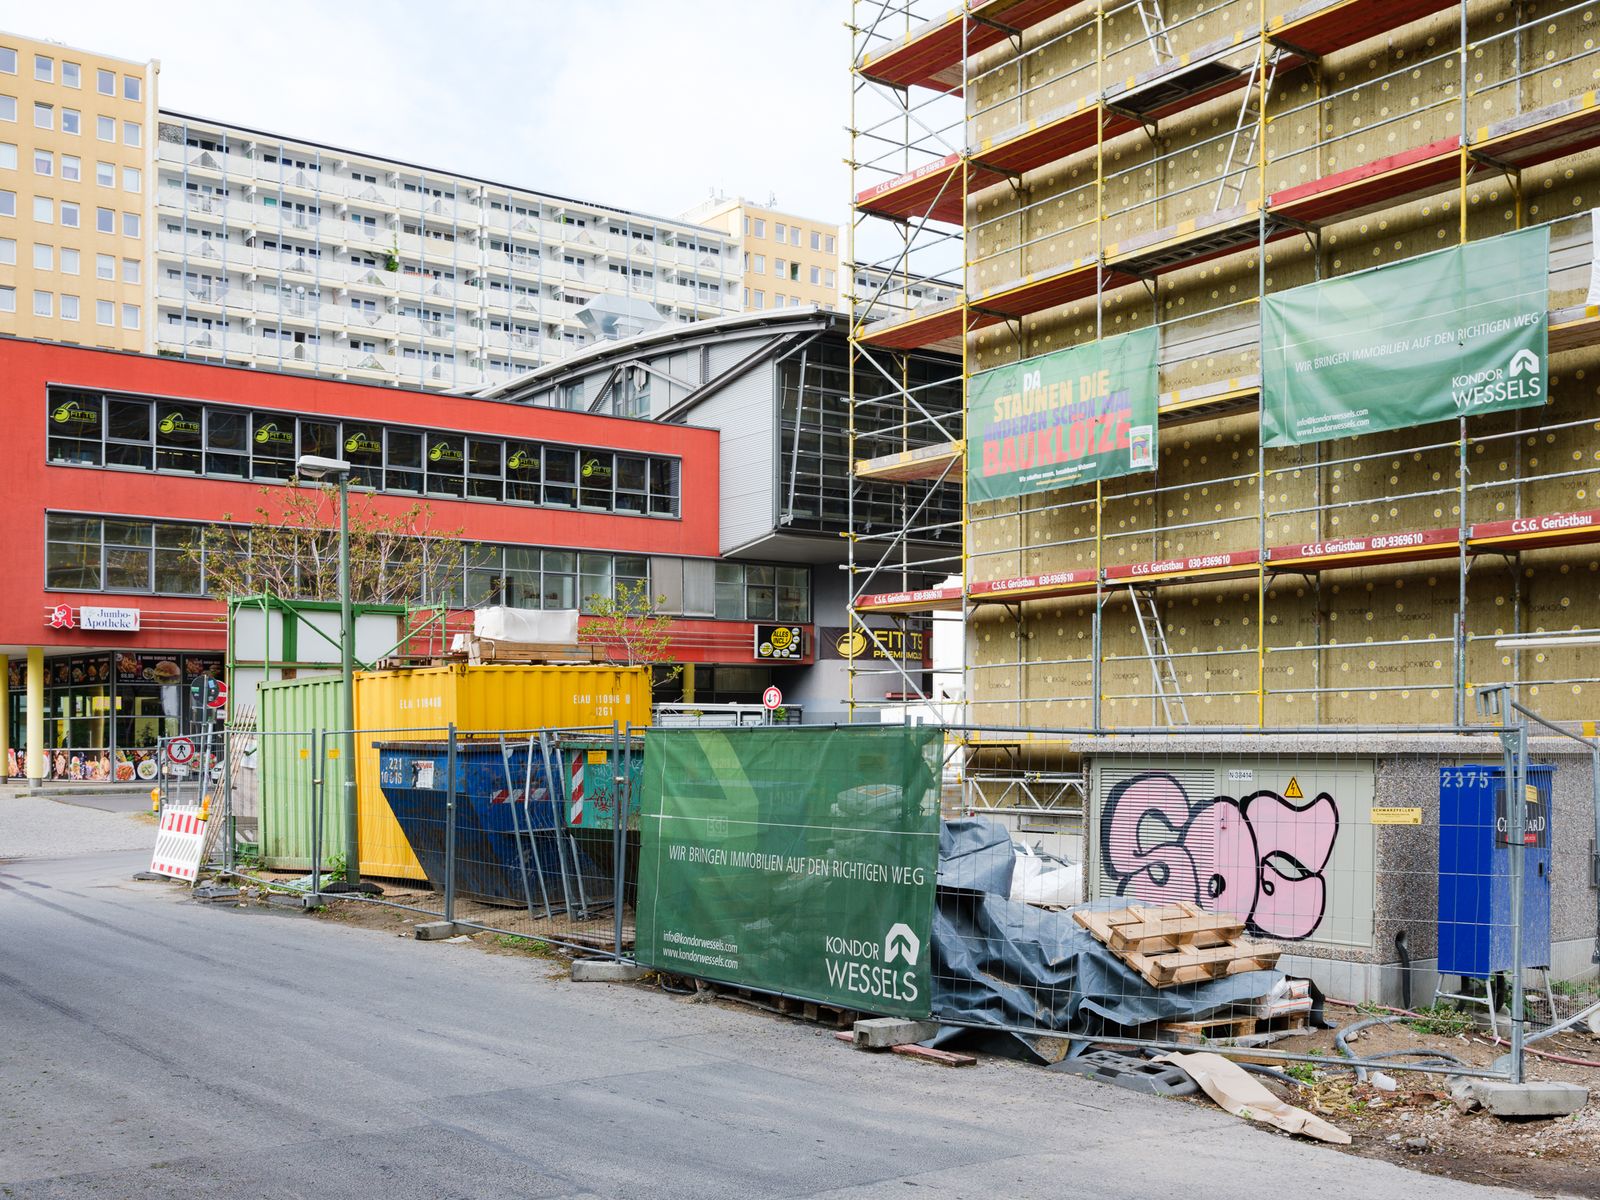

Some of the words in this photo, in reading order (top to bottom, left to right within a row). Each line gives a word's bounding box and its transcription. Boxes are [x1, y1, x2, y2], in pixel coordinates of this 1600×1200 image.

[1295, 361, 1313, 373] WIR
[1314, 352, 1350, 369] BRINGEN
[1352, 341, 1410, 360] IMMOBILIEN
[1412, 335, 1432, 351] AUF
[1435, 330, 1455, 345] DEN
[1457, 319, 1511, 340] RICHTIGEN
[1514, 311, 1540, 328] WEG
[1023, 370, 1041, 391] DA
[1452, 368, 1503, 388] KONDOR
[993, 379, 1073, 424] STAUNEN
[1079, 368, 1110, 398] DIE
[1452, 377, 1541, 409] WESSELS
[983, 412, 1048, 442] ANDEREN
[1296, 407, 1369, 427] info@kondorwessels.com
[1296, 418, 1370, 437] www.kondorwessels.com
[982, 407, 1133, 478] BAUKLÖTZE
[1512, 519, 1540, 533] C.S.G.
[1541, 514, 1592, 529] Gerüstbau
[1302, 544, 1323, 556] C.S.G.
[1325, 540, 1365, 554] Gerüstbau
[1371, 533, 1423, 549] 030-9369610
[1132, 564, 1150, 575] C.S.G.
[1151, 560, 1184, 573] Gerüstbau
[1188, 554, 1231, 569] 030-9369610
[992, 581, 1006, 591] C.S.G.
[1008, 577, 1035, 589] Gerüstbau
[1039, 573, 1074, 585] 030-9369610
[85, 617, 131, 629] Apotheke
[97, 609, 131, 618] Jumbo-
[1442, 771, 1489, 789] 2375
[669, 845, 686, 860] WIR
[689, 848, 727, 866] BRINGEN
[730, 851, 783, 872] IMMOBILIEN
[786, 857, 805, 874] AUF
[808, 859, 829, 876] DEN
[833, 861, 888, 882] RICHTIGEN
[891, 867, 924, 885] WEG
[663, 930, 738, 954] info@kondorwessels.com
[826, 936, 879, 960] KONDOR
[662, 947, 738, 970] www.kondorwessels.com
[825, 959, 918, 1002] WESSELS
